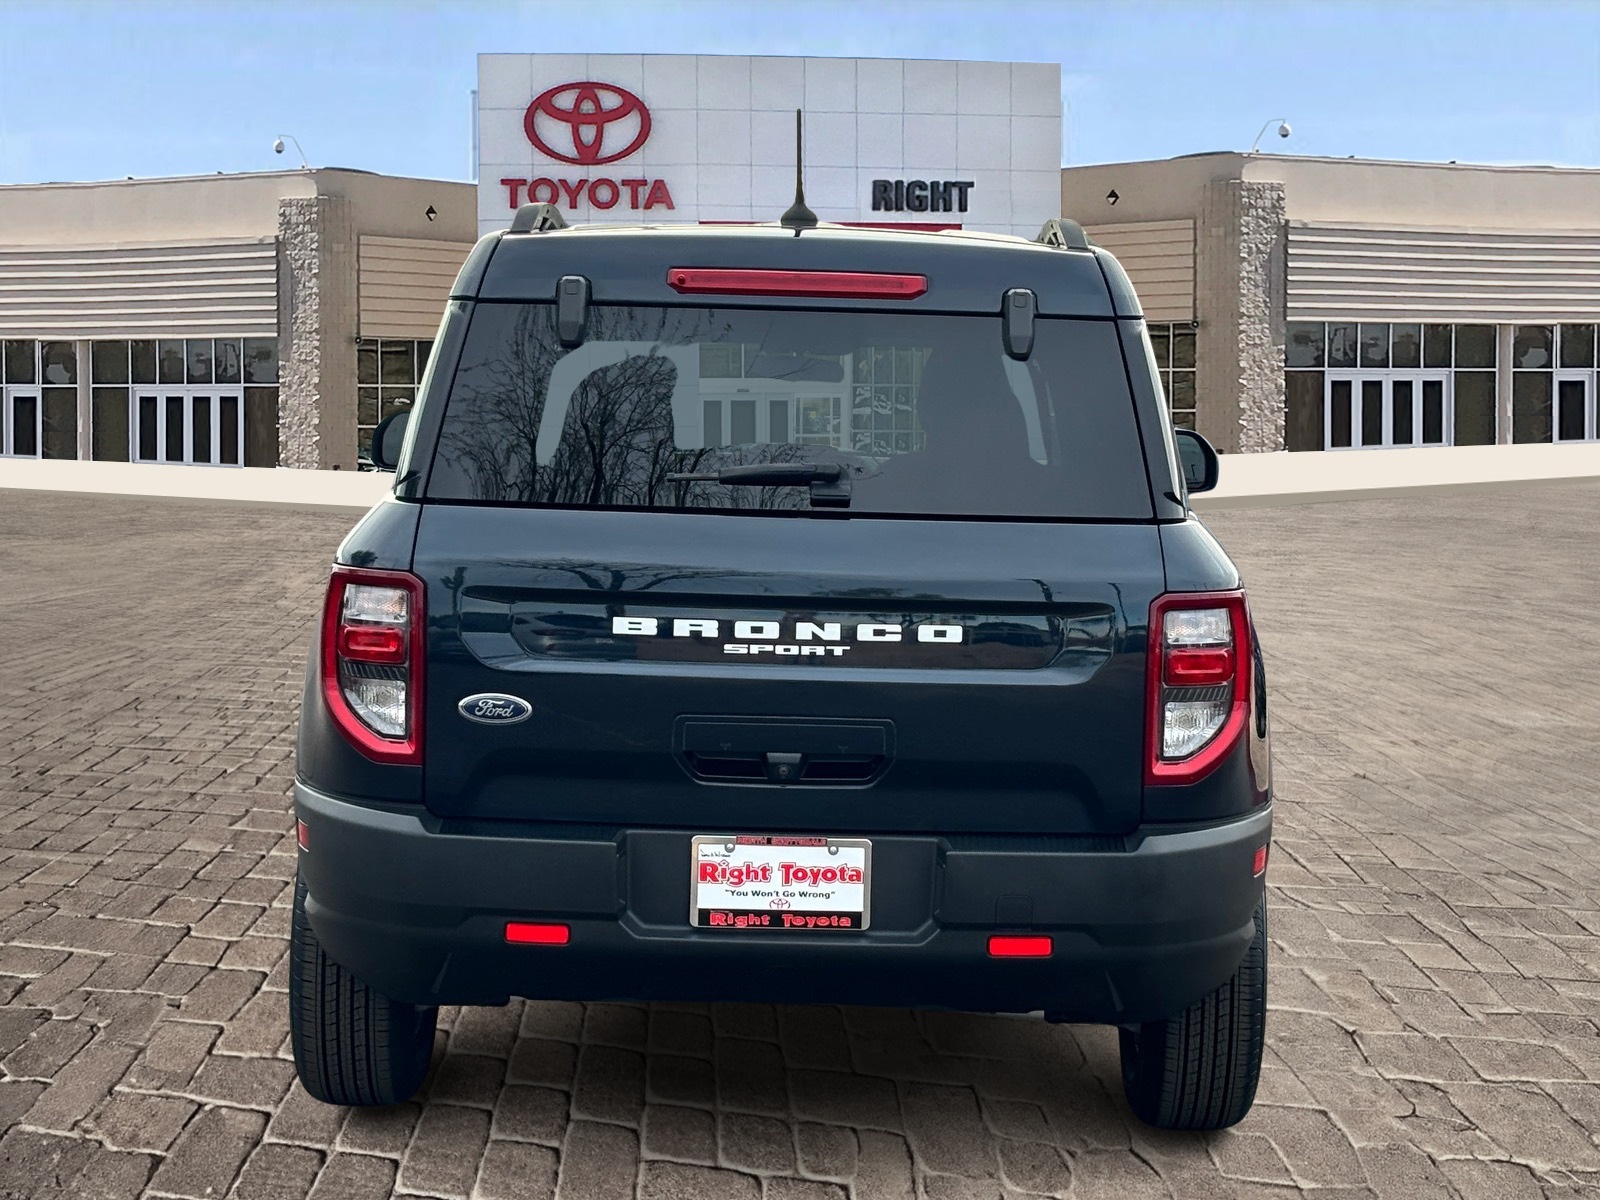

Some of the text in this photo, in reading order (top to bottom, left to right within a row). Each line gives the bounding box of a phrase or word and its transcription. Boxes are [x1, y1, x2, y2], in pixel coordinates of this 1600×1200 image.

[500, 178, 674, 211] TOYOTA
[871, 179, 975, 213] RIGHT
[612, 616, 963, 643] BRONCO
[723, 643, 851, 656] SPORT
[474, 699, 515, 717] Ford
[698, 860, 864, 887] Right Toyota
[751, 889, 780, 898] Won't
[782, 890, 796, 898] Go
[709, 910, 852, 928] Right Toyota
